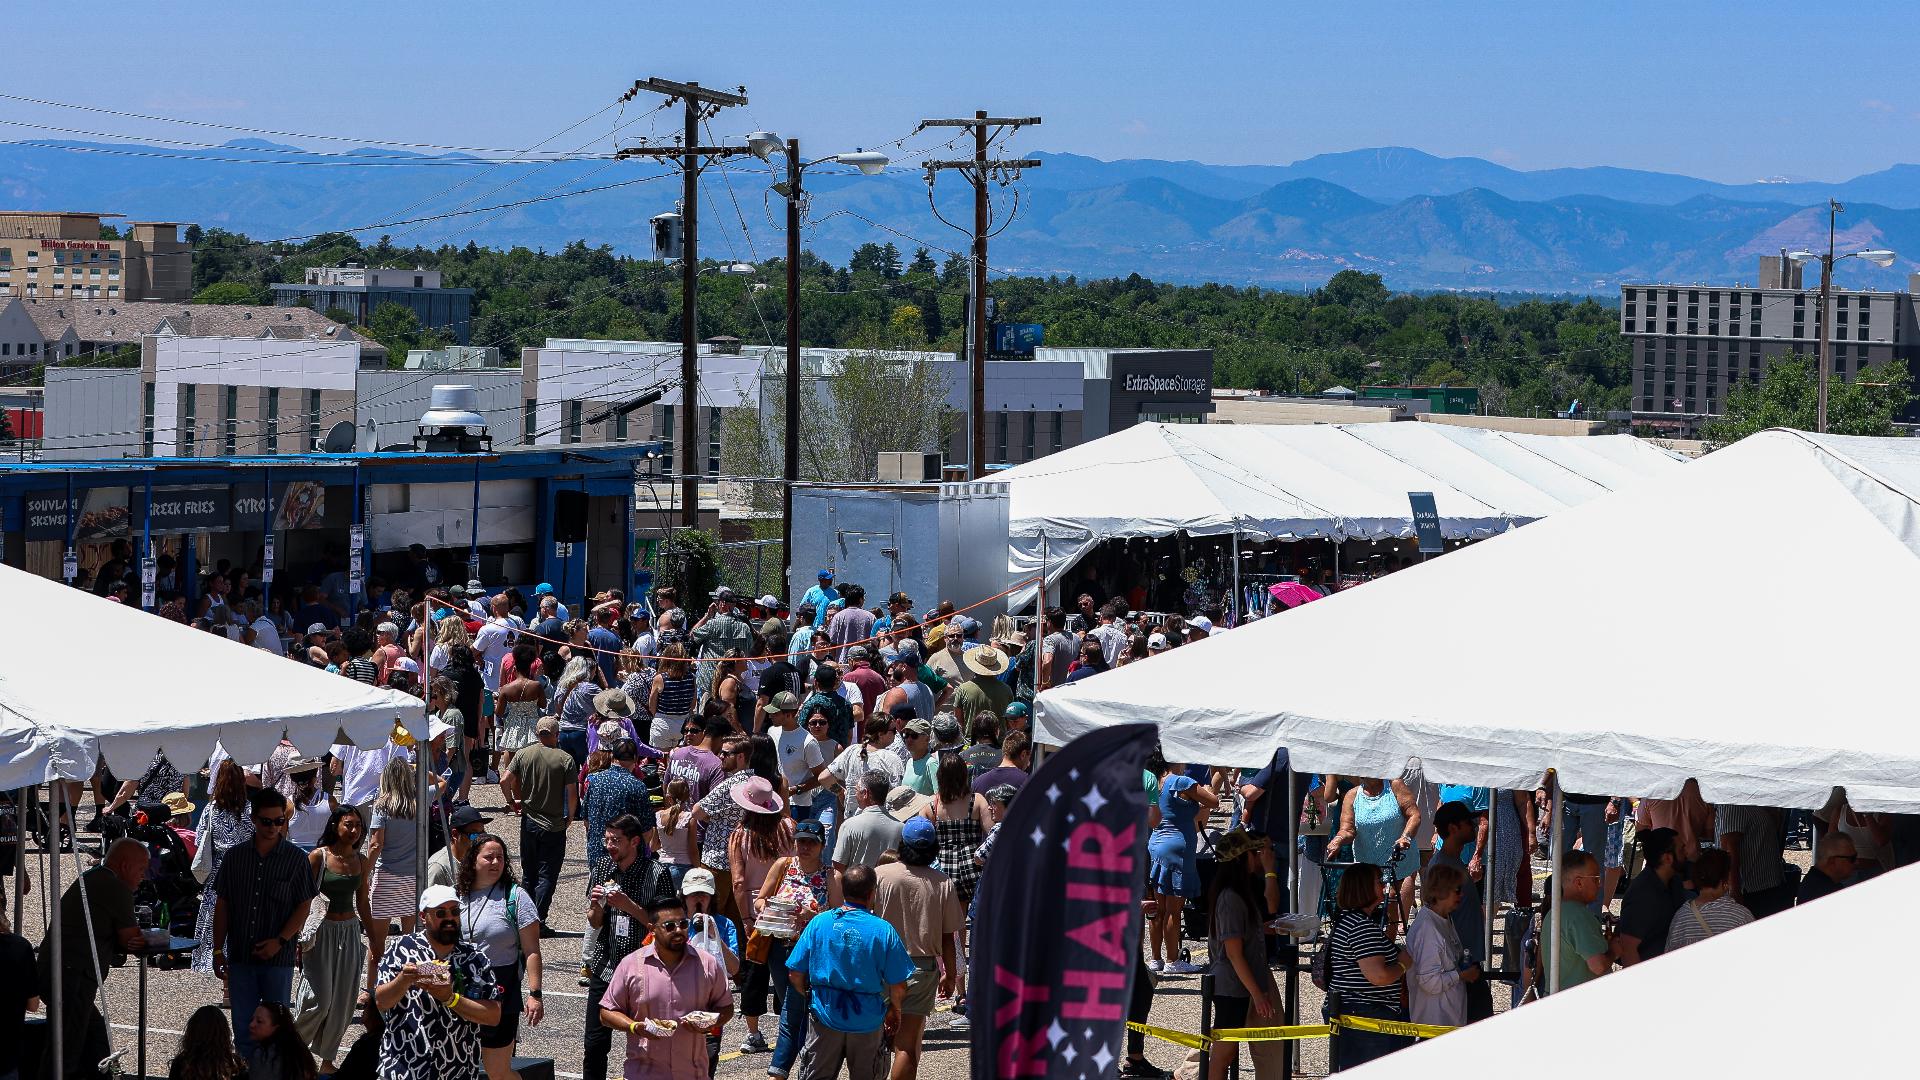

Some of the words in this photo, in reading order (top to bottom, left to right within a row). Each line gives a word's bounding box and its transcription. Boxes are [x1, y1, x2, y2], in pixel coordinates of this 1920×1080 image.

[41, 239, 66, 249] Hilton
[67, 240, 95, 250] Garden
[97, 241, 111, 250] Inn
[150, 501, 181, 516] REEK
[184, 500, 215, 515] FRIES
[234, 497, 275, 514] GYROS
[670, 759, 700, 782] Modelo
[1060, 820, 1137, 1021] HAIR
